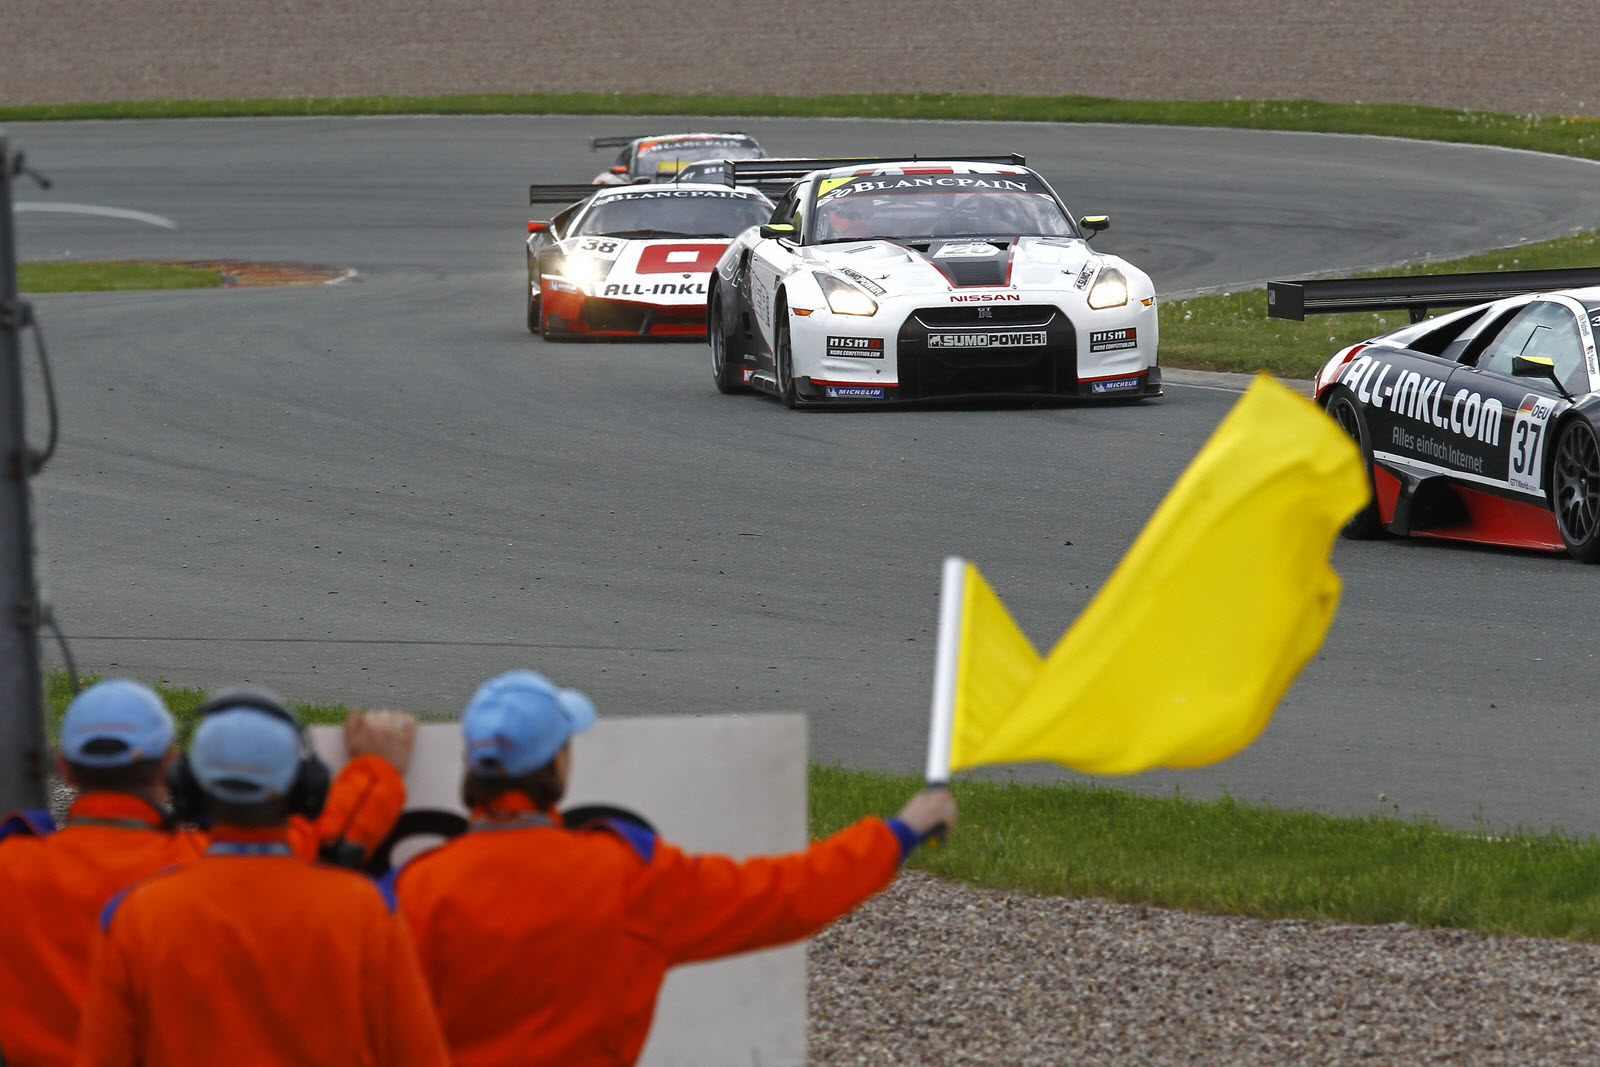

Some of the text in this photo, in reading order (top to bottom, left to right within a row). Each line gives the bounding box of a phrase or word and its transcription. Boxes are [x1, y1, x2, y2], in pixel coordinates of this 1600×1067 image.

[853, 178, 1027, 193] BLANCPAIN
[609, 190, 748, 201] BLANCPAIN
[823, 188, 854, 199] 20
[581, 239, 618, 253] 38
[950, 294, 1021, 302] NISSAN
[1106, 380, 1138, 389] MICHELIN
[1531, 404, 1551, 420] DEU
[1392, 426, 1484, 474] Alles einfach Internet
[1513, 419, 1542, 476] 37
